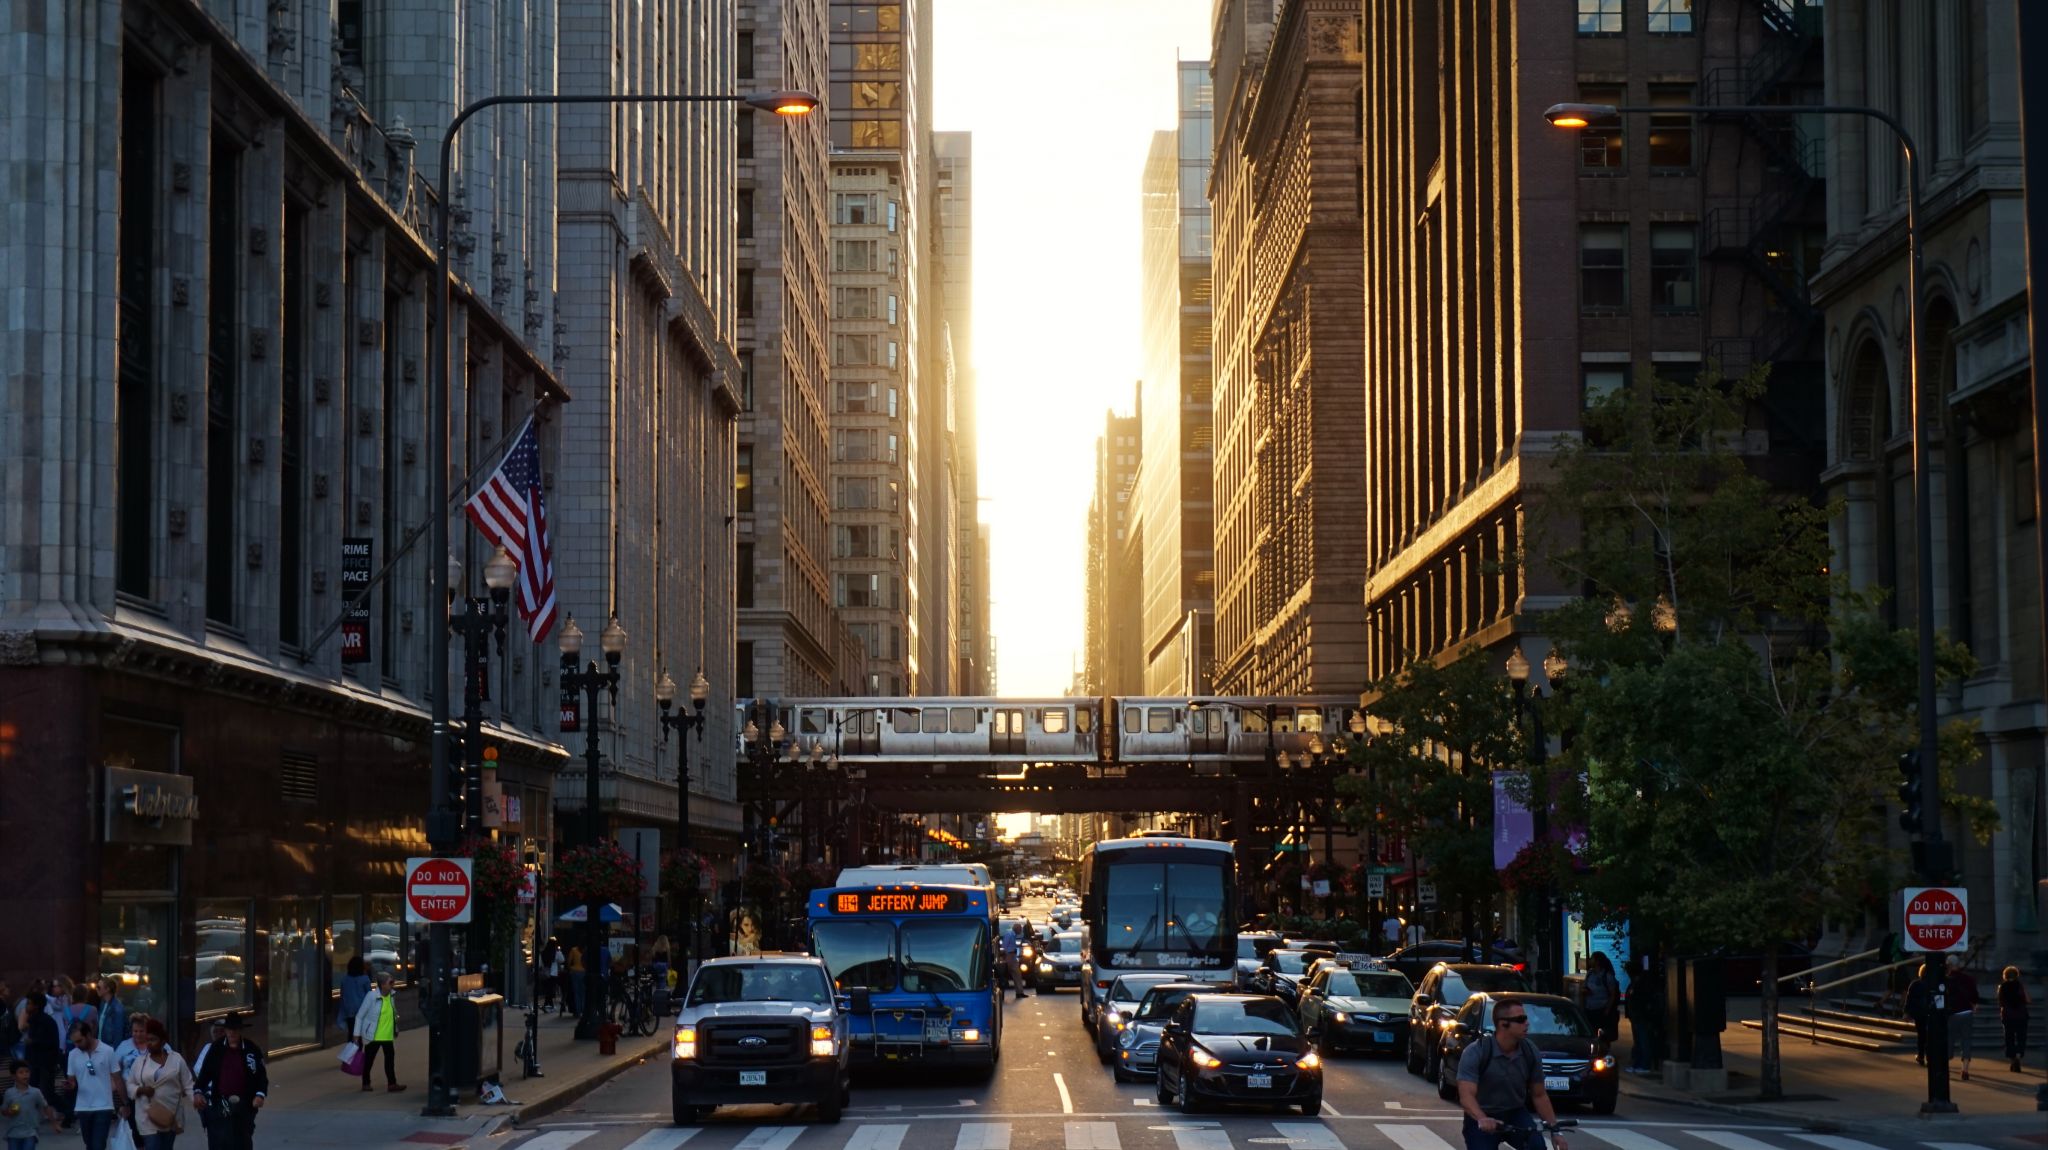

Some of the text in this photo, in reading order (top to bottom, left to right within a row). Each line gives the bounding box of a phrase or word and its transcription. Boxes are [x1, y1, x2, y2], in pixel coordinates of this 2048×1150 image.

[560, 710, 575, 722] MR
[417, 871, 461, 881] DO NOT
[421, 899, 456, 909] ENTER
[867, 894, 916, 911] JEFFERY
[918, 894, 948, 910] JUMP
[1914, 901, 1957, 911] DO NOT
[1919, 928, 1953, 939] ENTER
[1111, 952, 1221, 967] Free Enterprise
